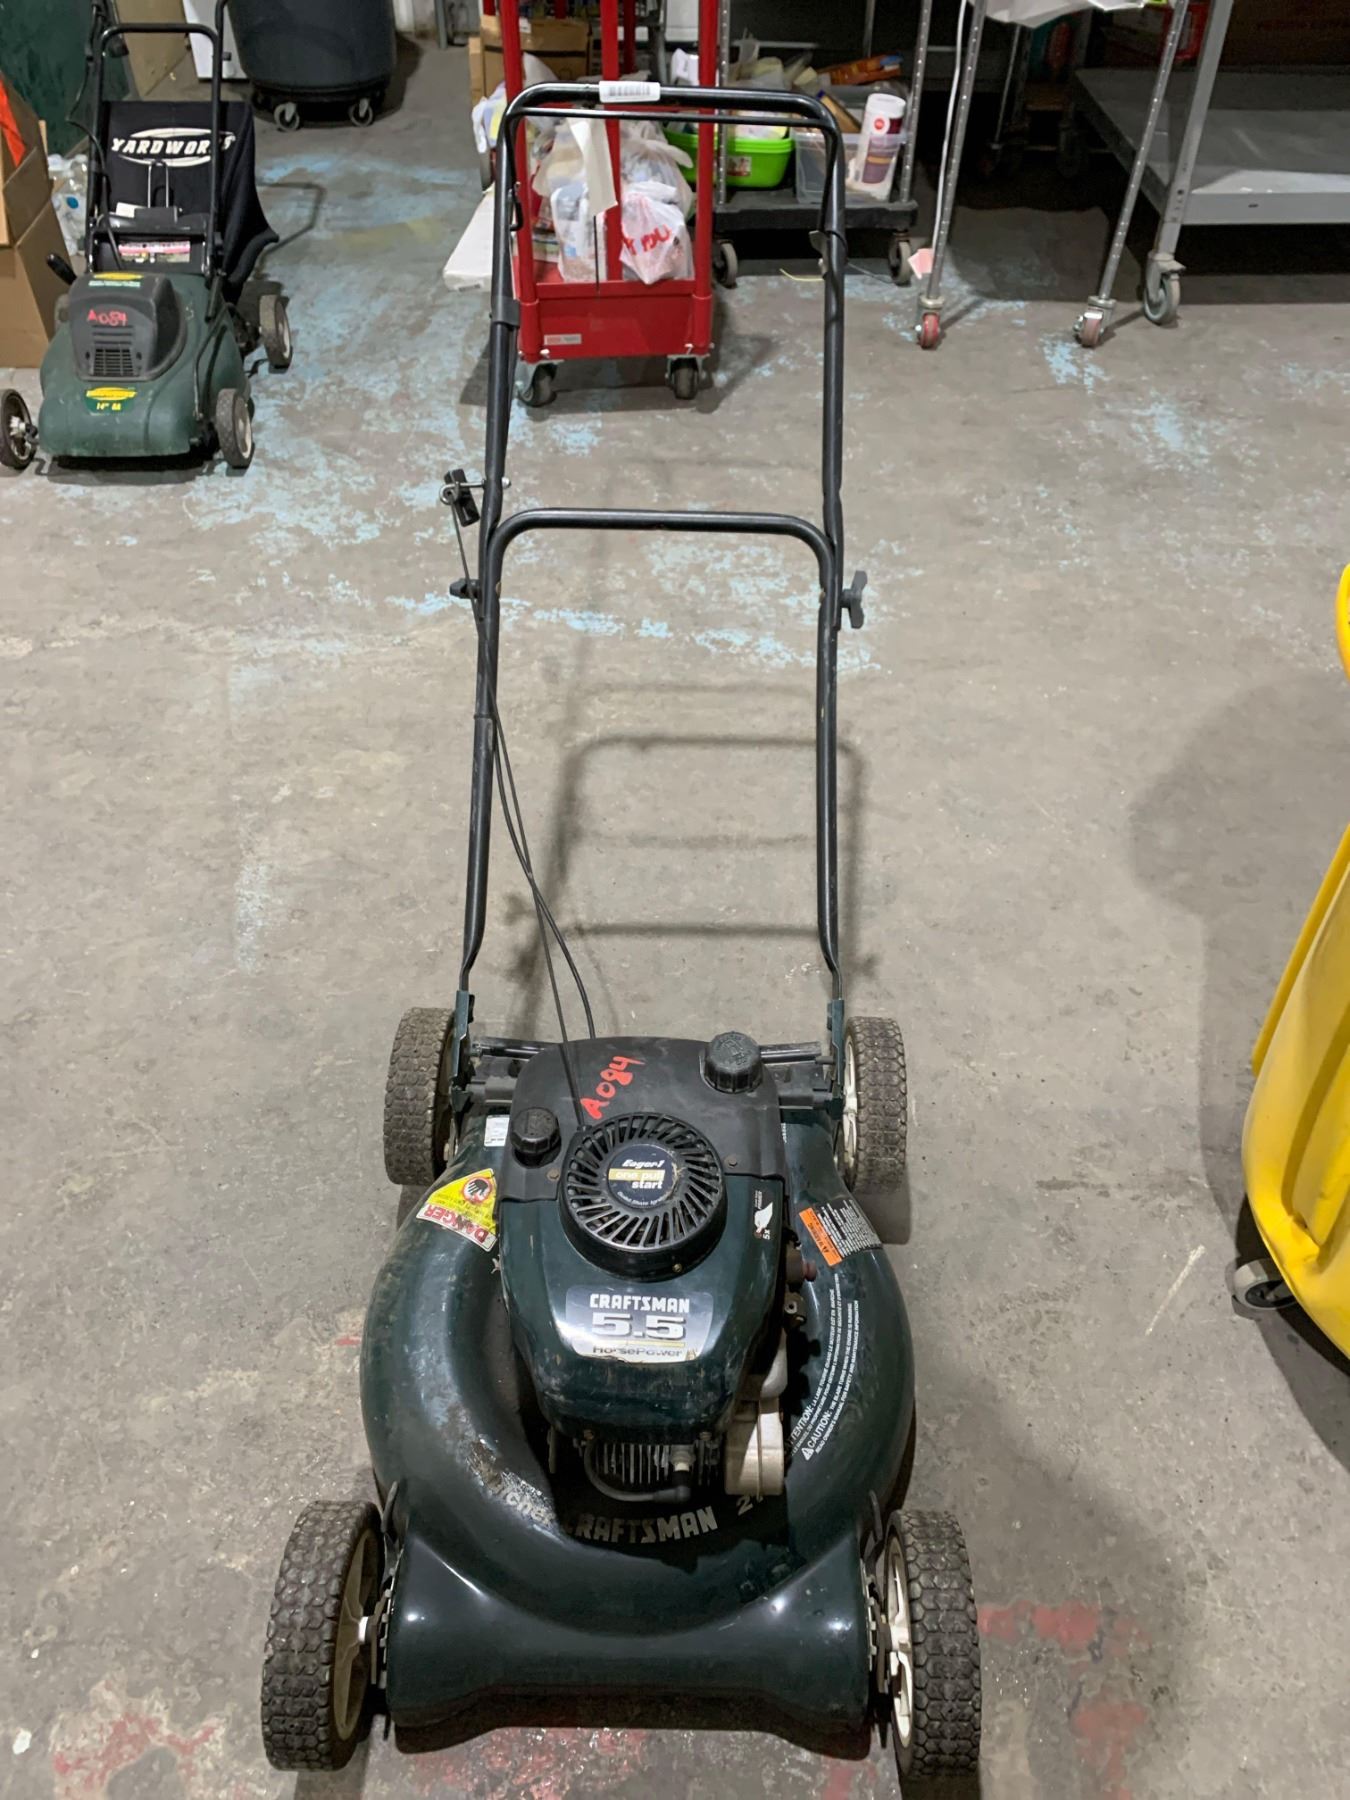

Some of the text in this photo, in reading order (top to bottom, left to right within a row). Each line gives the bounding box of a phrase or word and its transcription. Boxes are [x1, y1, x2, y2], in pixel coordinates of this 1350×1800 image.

[111, 135, 236, 155] YARDWORS
[580, 1056, 645, 1119] A084
[631, 1180, 663, 1189] start
[424, 1205, 489, 1243] DANGER
[590, 1293, 690, 1313] CRAFTSMAN
[591, 1312, 686, 1340] 5.5
[789, 1404, 814, 1444] TENTION:
[806, 1408, 832, 1448] CAUTION:
